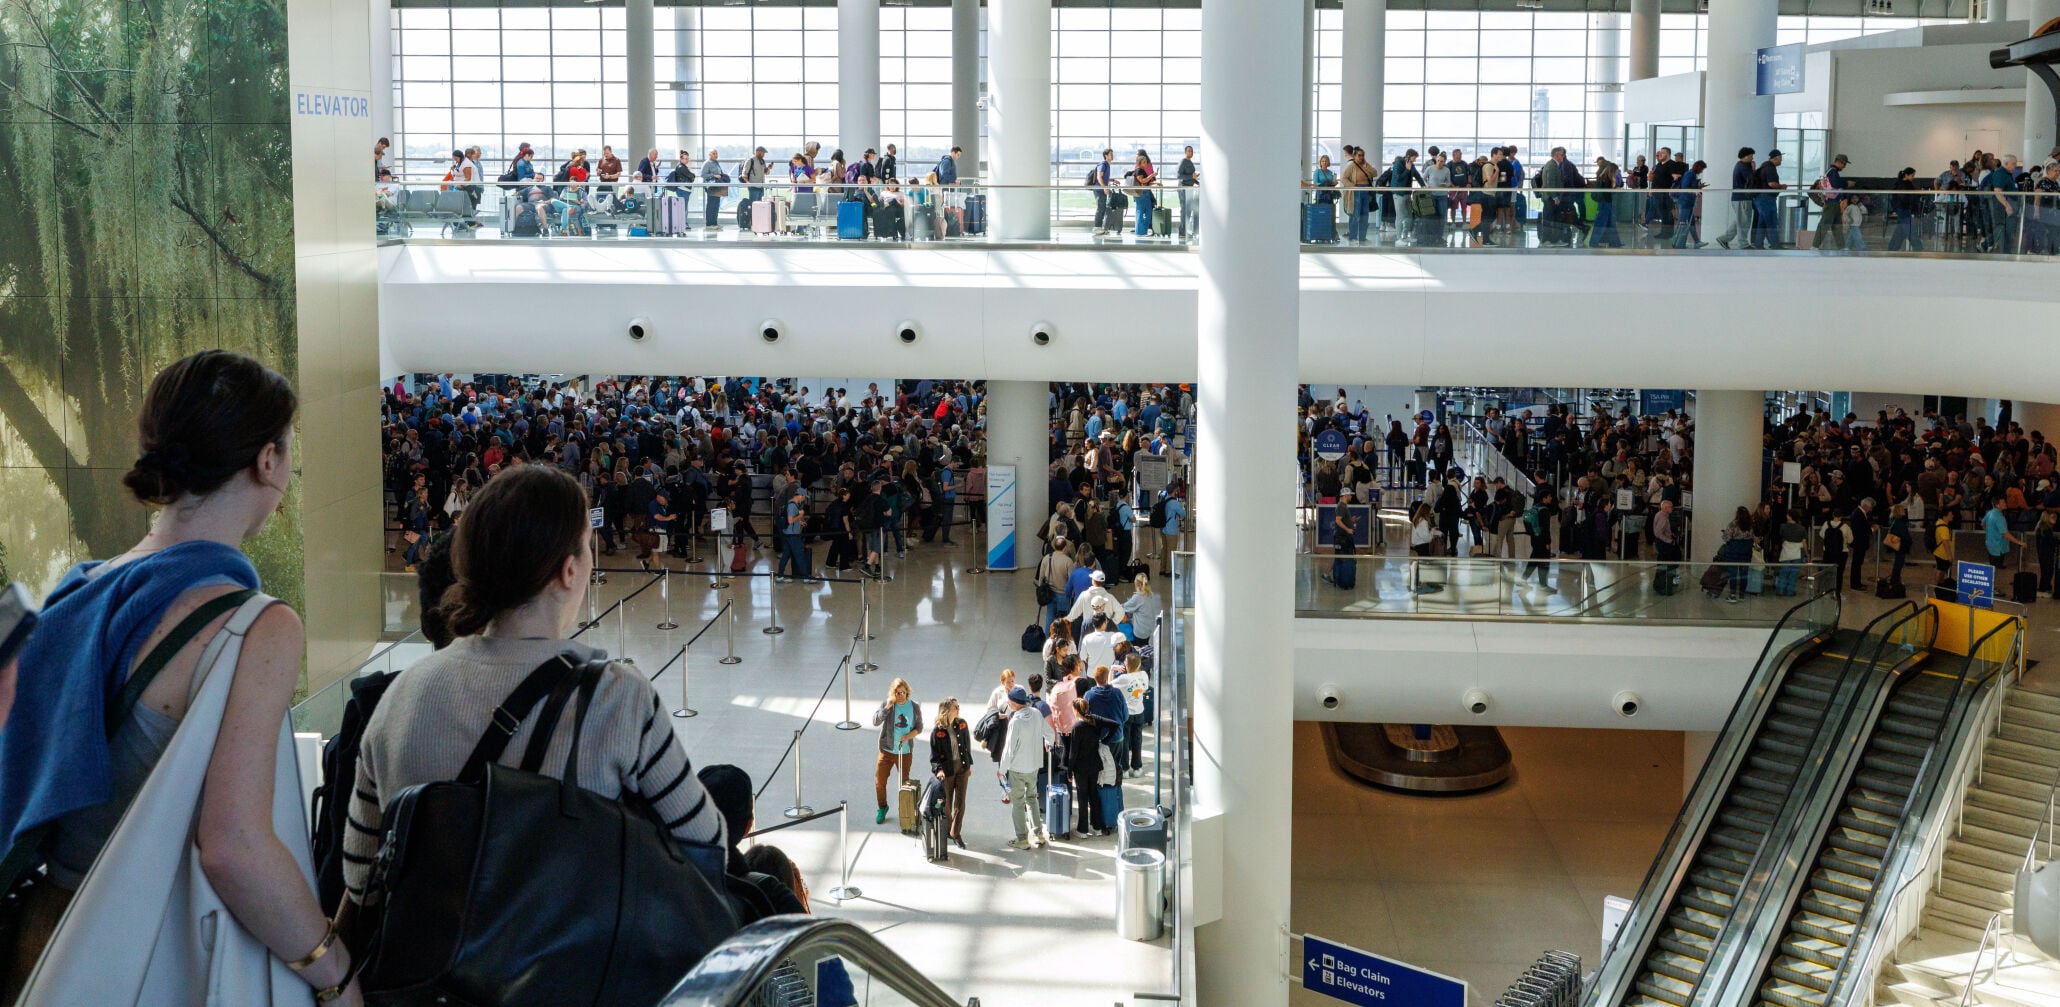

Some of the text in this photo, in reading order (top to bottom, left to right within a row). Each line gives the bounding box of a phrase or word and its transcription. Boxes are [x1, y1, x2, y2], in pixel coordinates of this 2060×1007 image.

[297, 93, 368, 117] ELEVATOR
[1961, 578, 1990, 587] ESCALATORS
[1337, 960, 1391, 985] Bag Claim
[1336, 976, 1385, 1000] Elevators
